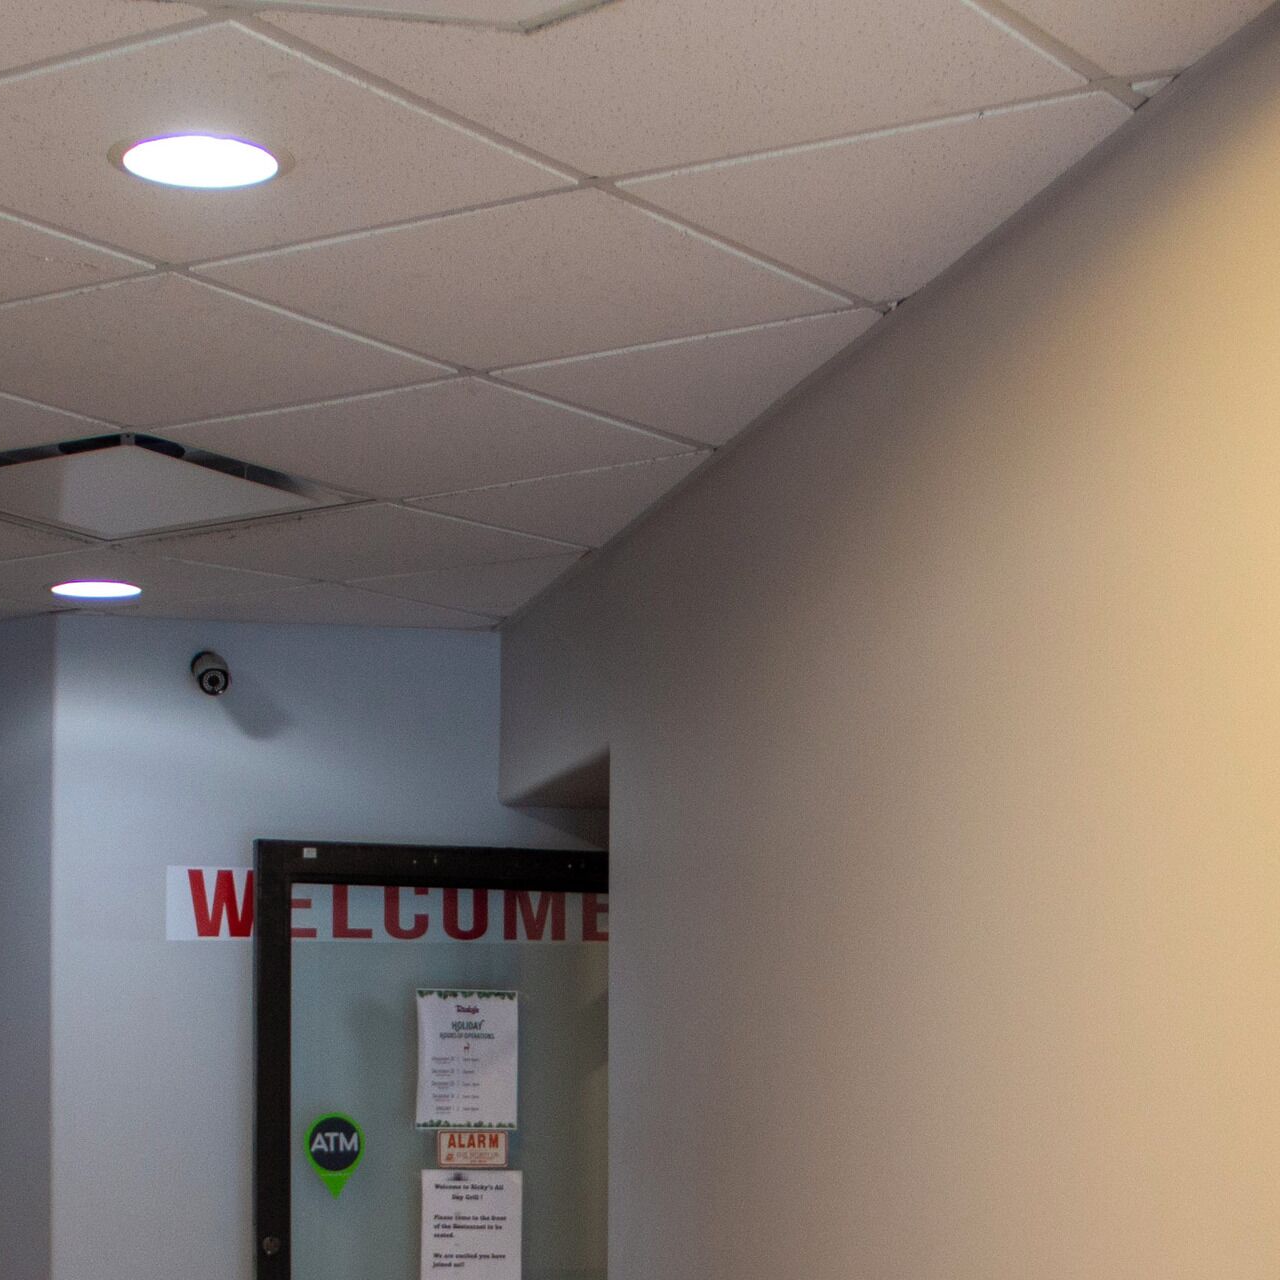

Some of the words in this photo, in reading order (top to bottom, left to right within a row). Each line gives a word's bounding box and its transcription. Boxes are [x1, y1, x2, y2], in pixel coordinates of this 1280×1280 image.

[451, 1020, 485, 1032] HOLIDAY
[311, 1132, 359, 1152] ATM
[448, 1134, 498, 1148] ALARM
